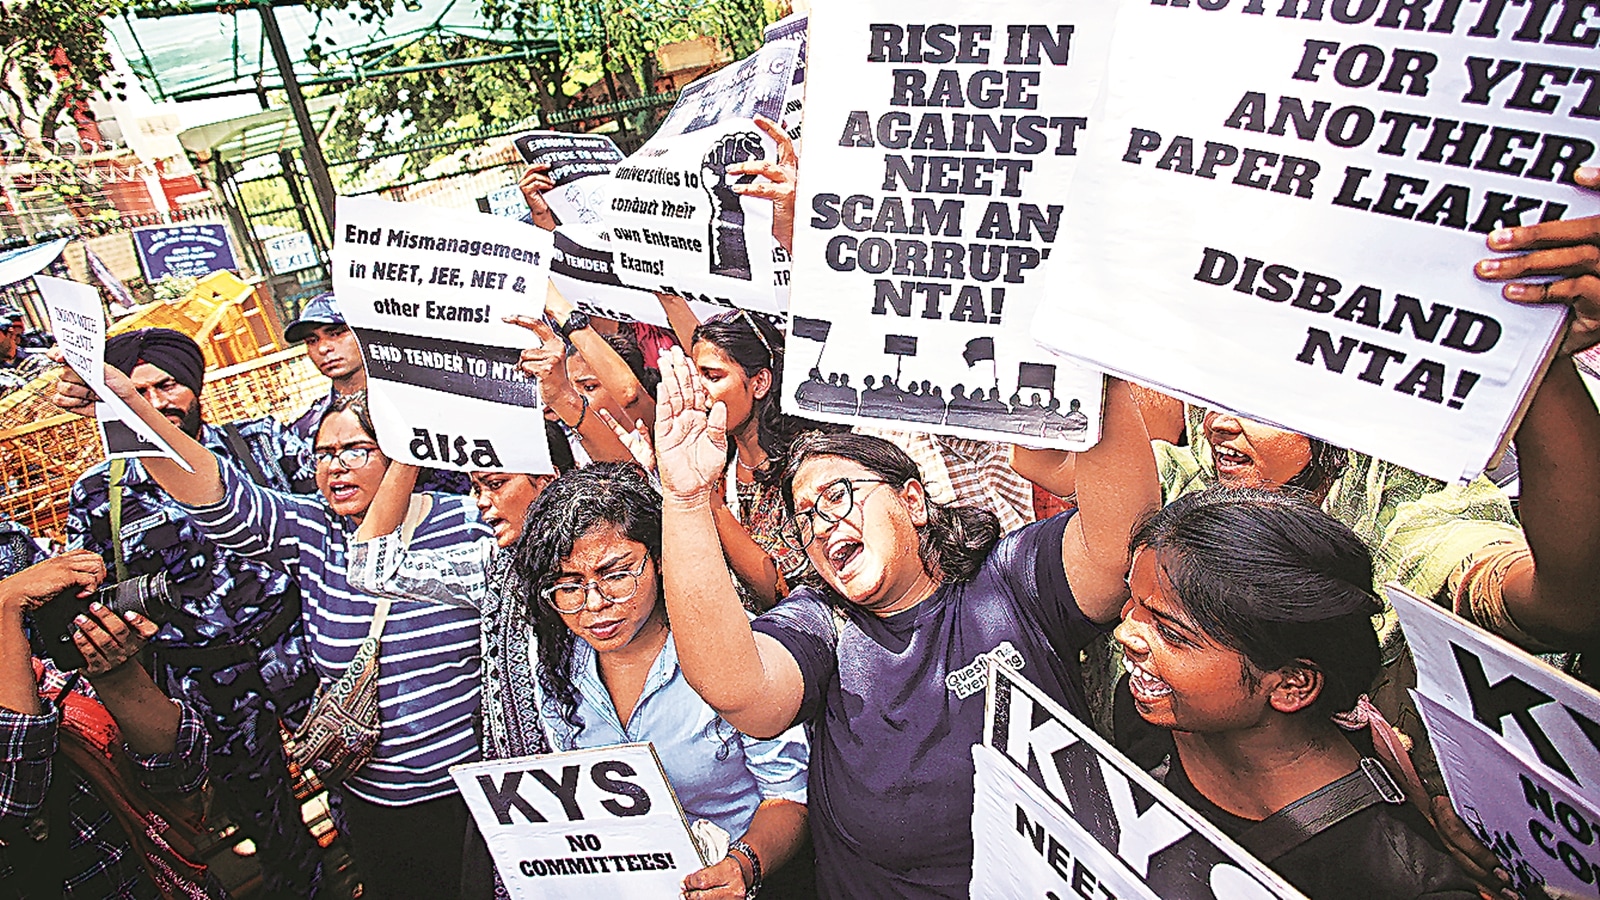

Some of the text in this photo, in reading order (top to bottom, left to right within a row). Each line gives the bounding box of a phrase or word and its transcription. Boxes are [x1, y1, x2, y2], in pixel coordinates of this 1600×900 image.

[867, 23, 1074, 66] RISE IN
[890, 68, 1040, 110] RAGE
[1292, 39, 1438, 97] FOR
[838, 110, 1087, 156] AGAINST
[1223, 90, 1596, 185] ANOTHER
[615, 166, 699, 189] universities to
[882, 154, 1032, 197] NEET
[1121, 127, 1321, 200] PAPER
[611, 197, 697, 219] conduct their
[810, 193, 1064, 243] SCAM AN
[345, 224, 541, 266] End Mismanagement
[613, 228, 642, 243] own
[642, 228, 703, 252] Entrance
[825, 234, 1052, 283] CORRUP
[349, 260, 526, 293] in NEET, JEE, NET &
[564, 253, 610, 273] TENDER
[620, 252, 664, 276] Exams!
[374, 298, 490, 323] other Exams!
[872, 279, 1006, 324] NTA!
[1193, 246, 1503, 354] DISBAND
[368, 343, 530, 384] END TENDER TO NTA
[1295, 326, 1482, 410] NTA!
[947, 649, 1006, 687] Questin
[475, 760, 652, 825] KYS
[519, 852, 678, 877] COMMITTEES!
[564, 834, 602, 853] NO
